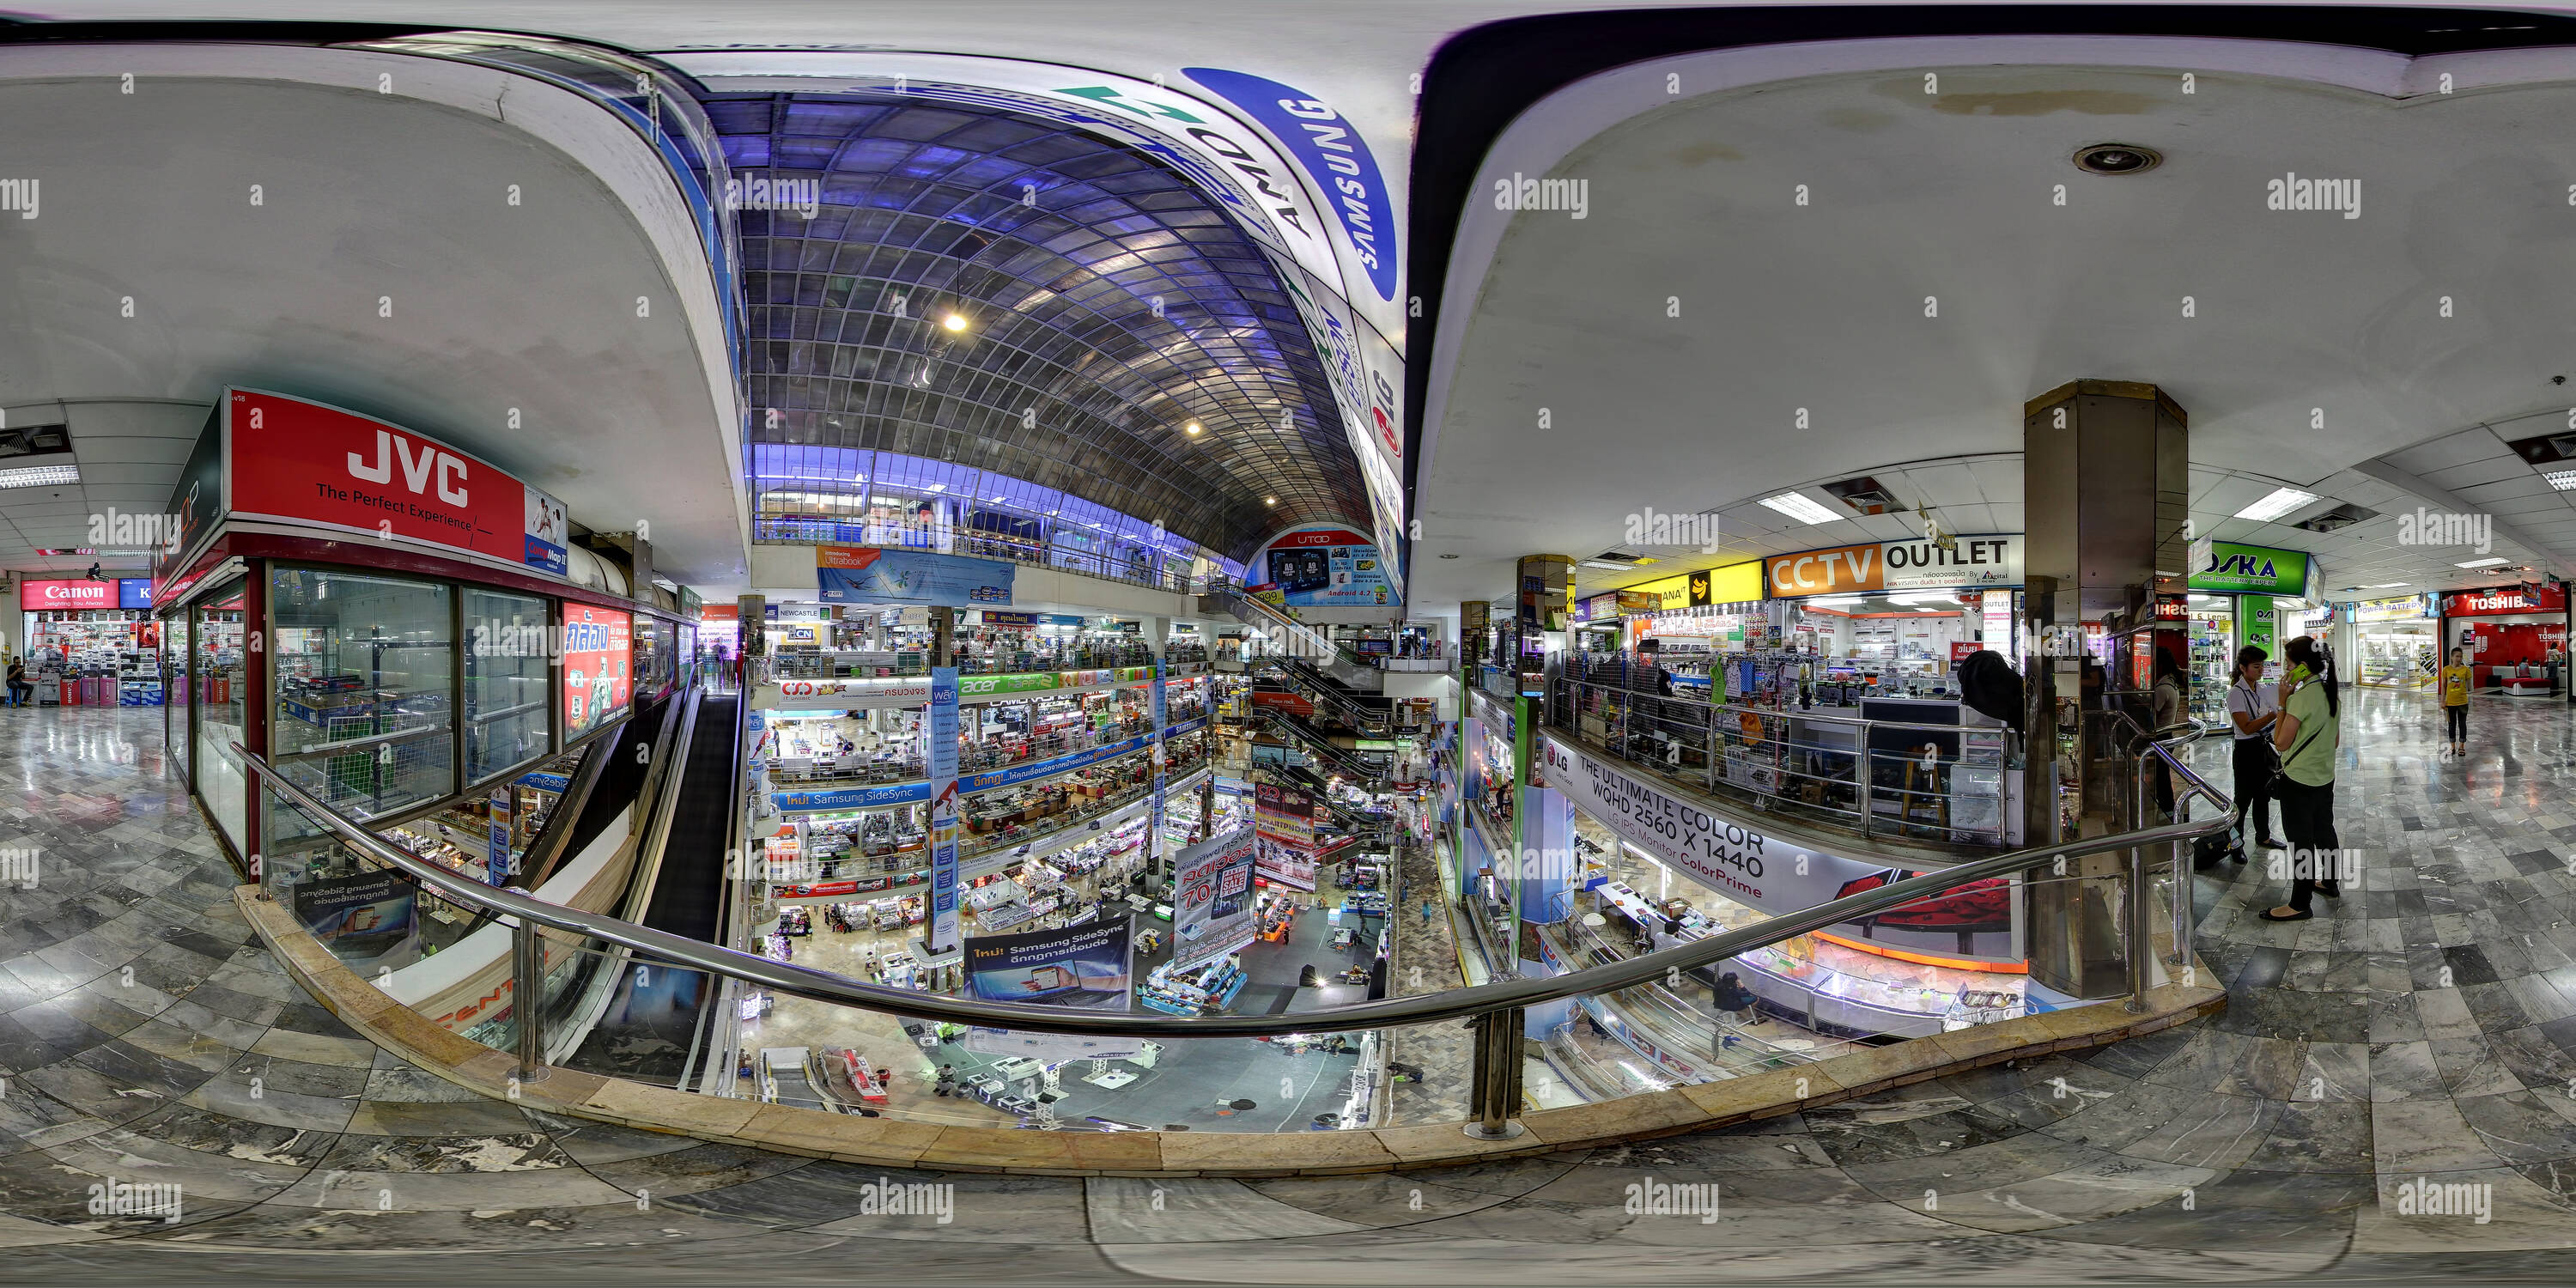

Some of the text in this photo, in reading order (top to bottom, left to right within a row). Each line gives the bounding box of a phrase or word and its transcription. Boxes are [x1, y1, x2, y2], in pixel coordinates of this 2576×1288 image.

[1186, 127, 1311, 240] AMD
[1278, 99, 1378, 270] SAMSUNG
[1320, 304, 1362, 410] EPSON
[348, 429, 468, 508] JVC
[316, 483, 471, 532] The Perfect Experience
[825, 556, 861, 565] Ultrabook
[1771, 540, 2008, 590] CCTV OUTLET
[2203, 550, 2277, 579] OSKA
[2215, 576, 2249, 585] BATTERY
[45, 586, 104, 598] Canon
[1662, 589, 1681, 601] ANA
[2358, 602, 2421, 615] POWER BATTERY
[2469, 595, 2535, 611] TOSHIB
[565, 610, 609, 653] กล้อง
[1958, 643, 1978, 653] ขโมย
[884, 688, 926, 696] ครบวงจร
[961, 679, 1000, 692] acer
[933, 690, 957, 702] พลิก
[1176, 721, 1198, 734] SAMSUNG
[1557, 752, 1568, 773] LG
[786, 789, 914, 805] ใหม่! Samsung SideSync
[1581, 756, 1765, 855] THE ULTIMATE COLOR
[1593, 780, 1764, 878] WQHD 2560 X 1440
[1607, 809, 1763, 899] LG IPS Monitor ColorPrime
[1223, 878, 1245, 891] SALE
[1070, 910, 1097, 926] SAMSUNG
[974, 925, 1124, 958] ใหม่! Samsung SideSync
